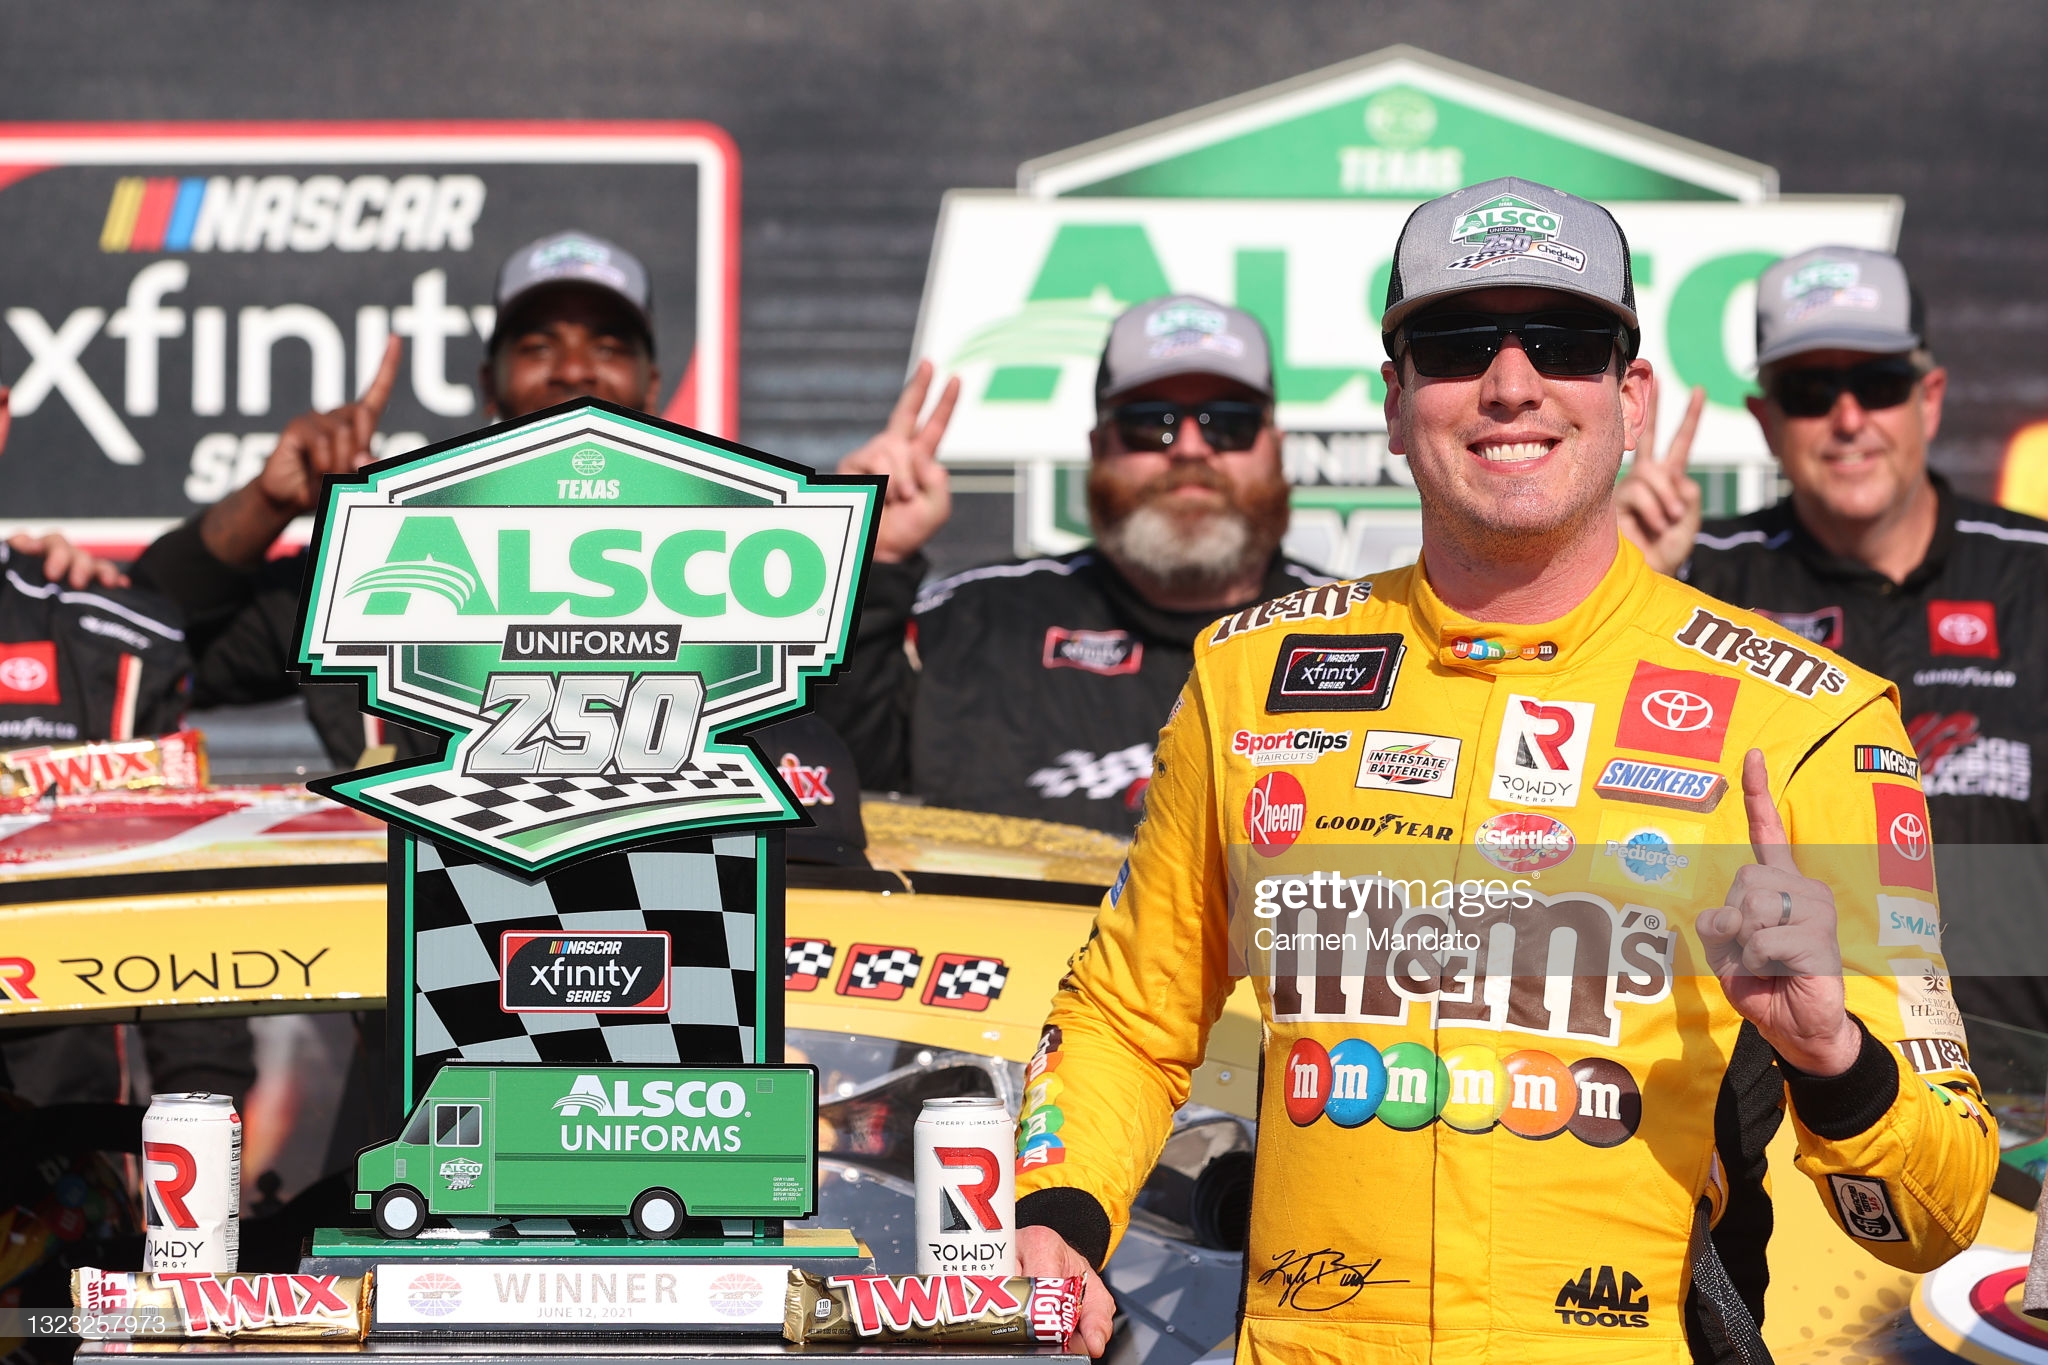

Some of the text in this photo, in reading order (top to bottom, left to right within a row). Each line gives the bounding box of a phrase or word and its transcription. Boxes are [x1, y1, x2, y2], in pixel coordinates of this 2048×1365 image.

[192, 174, 486, 252] NASCAR
[1457, 210, 1557, 234] ALSCO
[1480, 234, 1533, 254] 250
[5, 260, 496, 465] xfinit
[556, 478, 620, 500] TEXAS
[343, 515, 827, 618] ALSCO
[515, 630, 670, 656] UNIFORMS
[1326, 653, 1361, 663] NASCAR
[1301, 663, 1367, 686] xfinity
[1317, 681, 1346, 690] SERIES
[464, 671, 708, 777] 250
[1256, 752, 1315, 762] HAIRCUTS
[1369, 752, 1447, 769] INTERSTATE
[1369, 763, 1440, 780] BATTERIES
[1602, 761, 1714, 798] SNICKERS
[1498, 775, 1573, 797] ROWDY
[1250, 772, 1304, 845] Rheem
[1509, 793, 1554, 803] ENERGY
[1485, 829, 1570, 852] Skittles
[1603, 839, 1689, 869] Pedigree
[566, 940, 623, 955] NASCAR
[58, 947, 330, 996] ROWDY
[529, 956, 643, 996] xfinity
[565, 990, 612, 1003] SERIES
[551, 1074, 748, 1118] ALSCO
[560, 1125, 742, 1153] UNIFORMS
[443, 1164, 481, 1173] ALSCO
[928, 1242, 1007, 1261] ROWDY
[943, 1263, 996, 1272] ENERGY
[493, 1273, 678, 1304] WINNER
[1554, 1265, 1650, 1312] MAC
[155, 1271, 352, 1333] TWIX
[537, 1307, 633, 1320] JUNE 12, 2021
[819, 1300, 829, 1309] 110
[829, 1273, 1021, 1336] TWIX
[1033, 1277, 1064, 1343] RIGHT
[1061, 1293, 1075, 1332] FOUR
[1554, 1309, 1650, 1328] TOOLS
